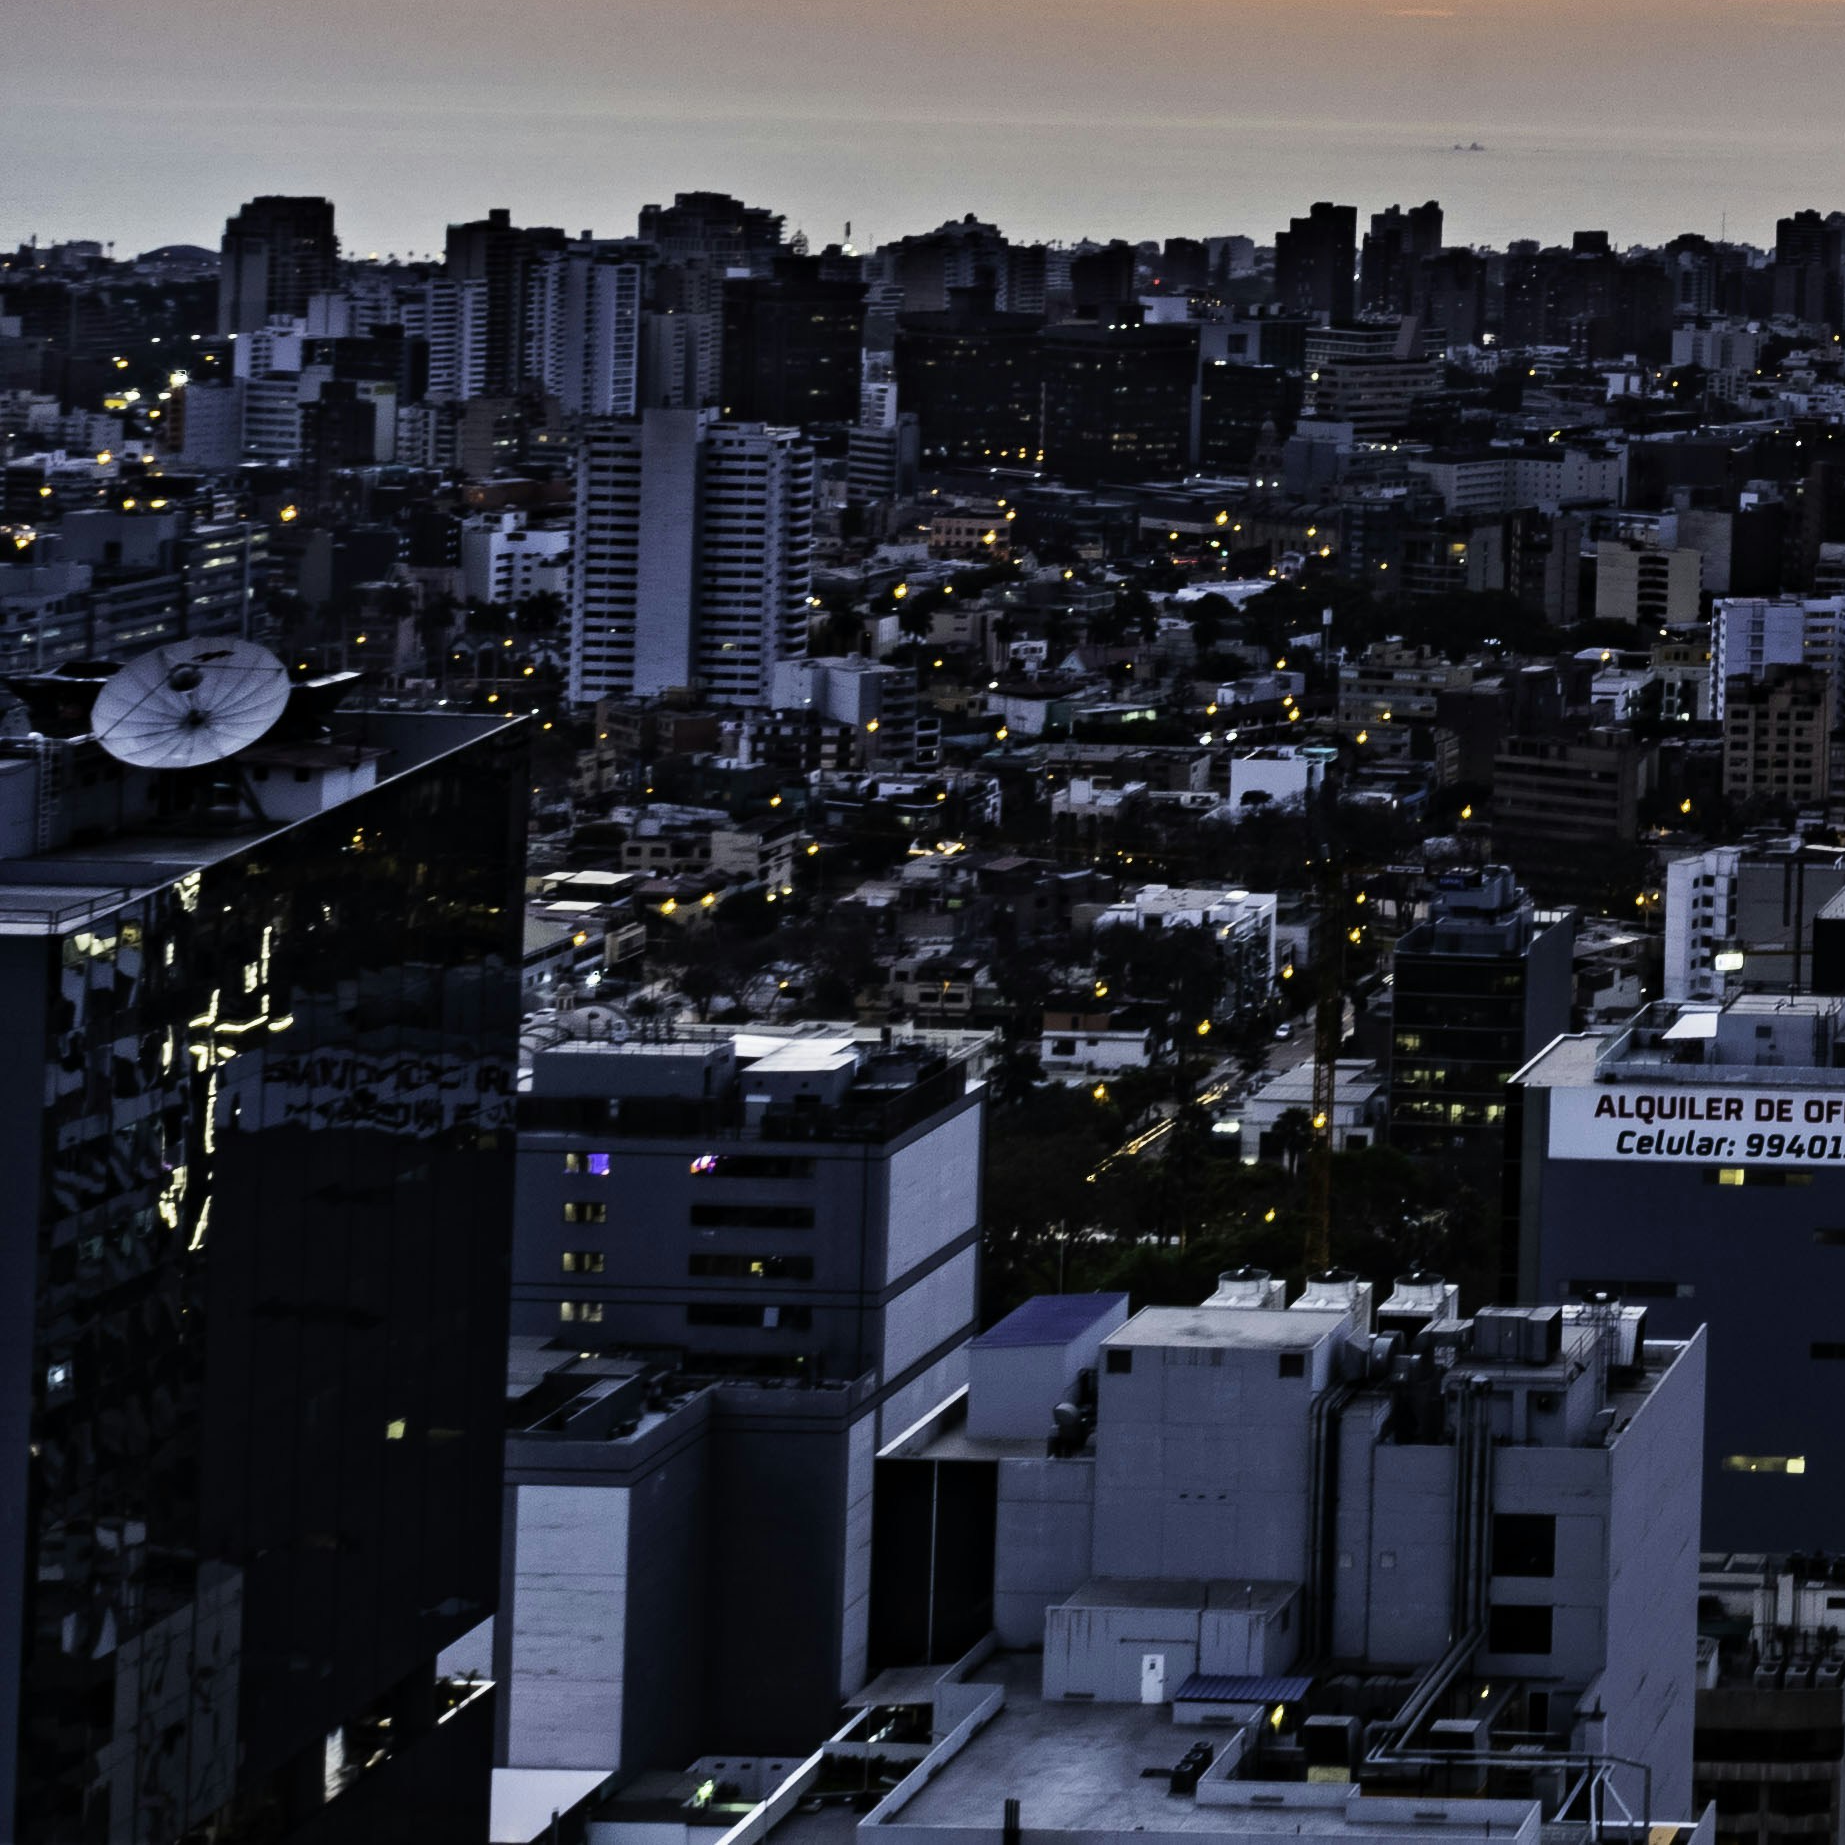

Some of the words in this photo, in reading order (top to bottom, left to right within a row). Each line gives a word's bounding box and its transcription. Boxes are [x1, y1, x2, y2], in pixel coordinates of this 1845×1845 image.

[1594, 1094, 1744, 1124] ALQUILER
[1755, 1098, 1794, 1123] DE
[1616, 1130, 1735, 1157] Celular:
